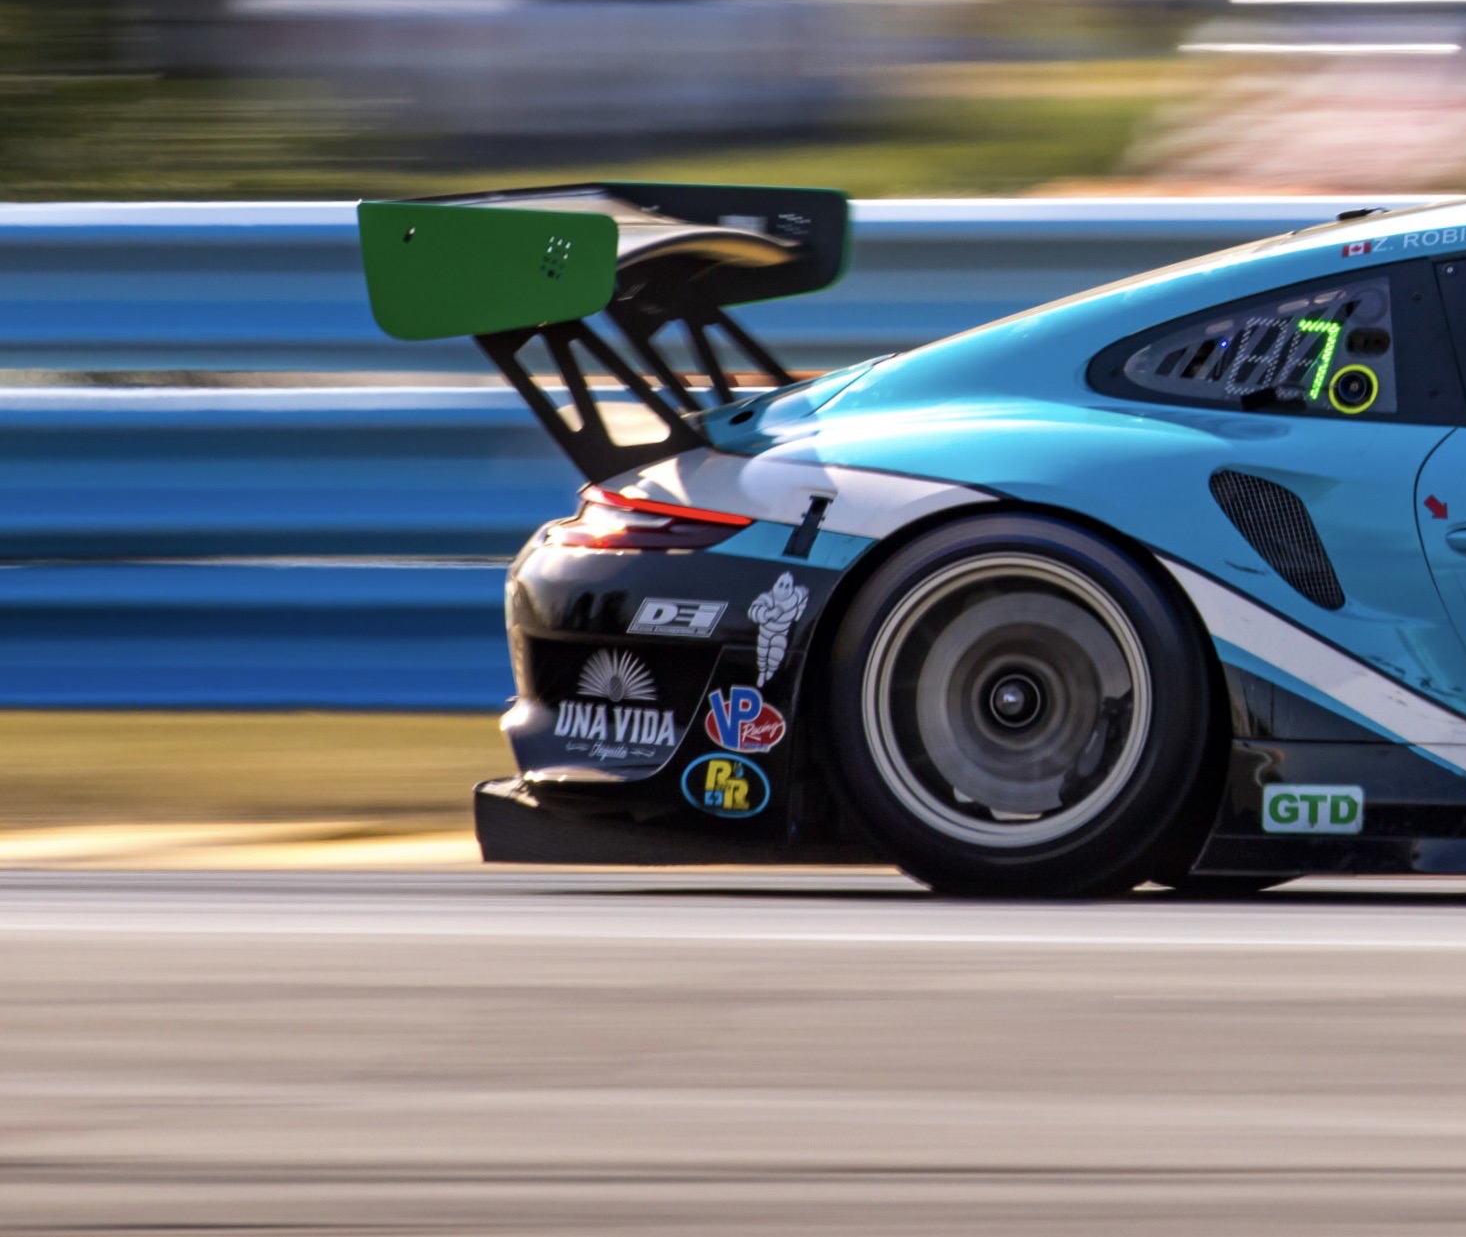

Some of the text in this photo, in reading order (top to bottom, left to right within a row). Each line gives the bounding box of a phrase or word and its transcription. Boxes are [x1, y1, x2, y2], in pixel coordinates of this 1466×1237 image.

[1372, 237, 1393, 252] Z.
[554, 700, 675, 746] UNA VIDA
[709, 685, 763, 751] VP
[1268, 792, 1359, 825] GTD
